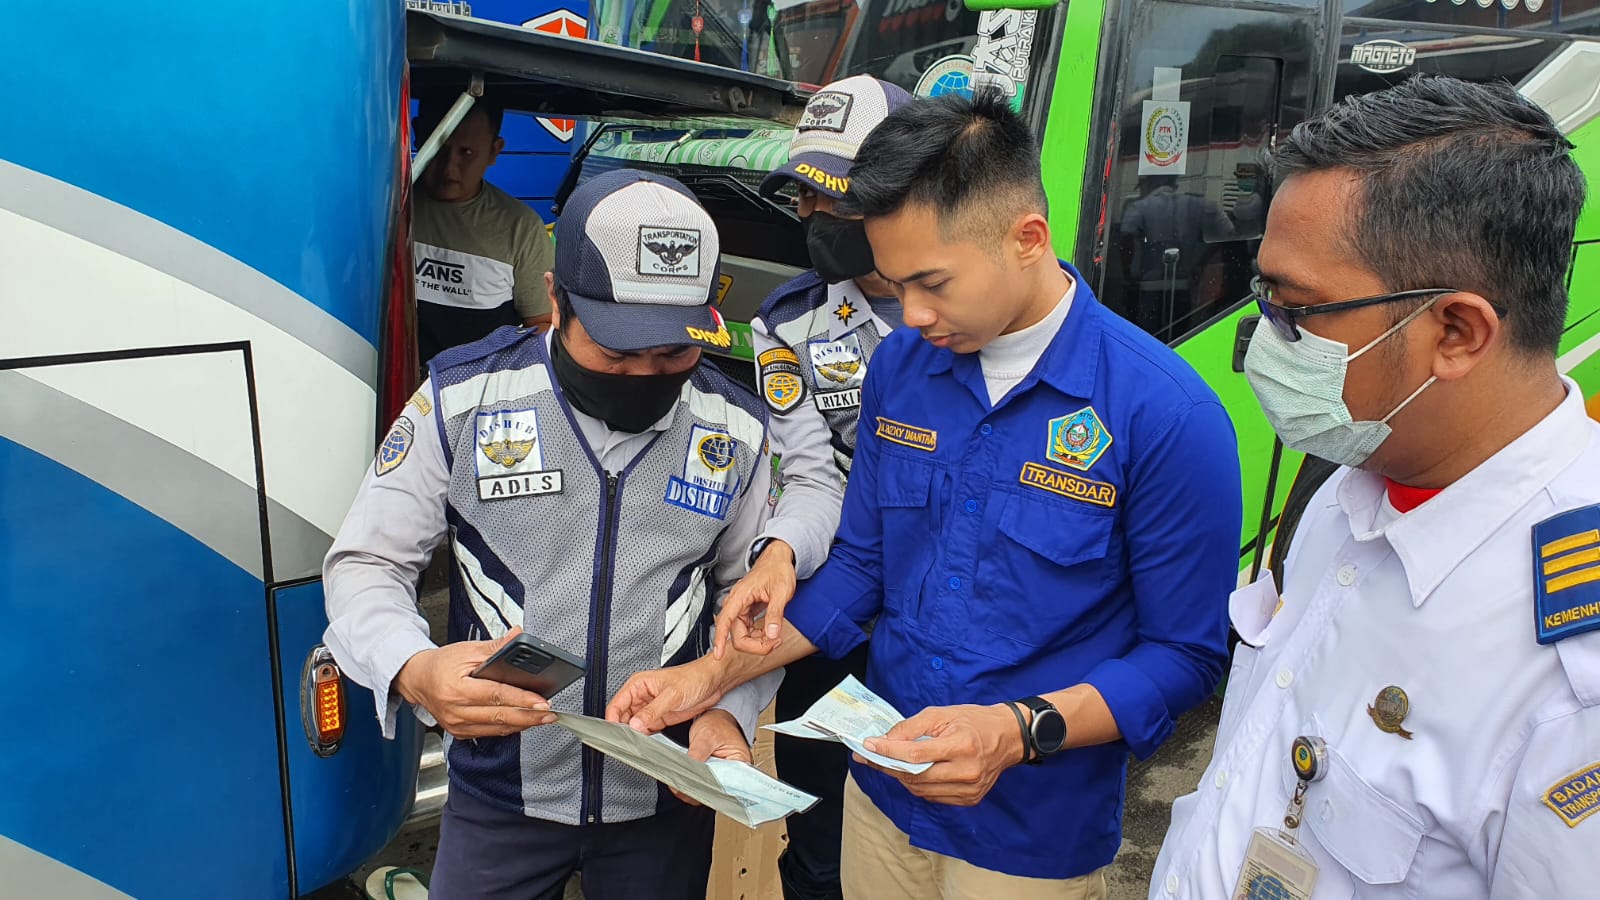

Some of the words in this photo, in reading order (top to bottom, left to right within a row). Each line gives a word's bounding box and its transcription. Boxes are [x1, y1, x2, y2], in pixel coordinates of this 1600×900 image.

[1014, 26, 1035, 80] PUTRA
[1350, 45, 1416, 65] MAGNETO
[805, 118, 833, 126] CORPS
[795, 163, 849, 194] DISHU
[643, 231, 698, 244] TRANSPORTATION
[414, 256, 465, 284] VANS
[652, 263, 689, 273] CORPS
[422, 281, 440, 291] THE
[814, 345, 859, 361] DISHUB
[822, 392, 856, 408] RIZKI
[479, 420, 534, 438] DISHUB
[1027, 467, 1111, 501] TRANSDAR
[1544, 601, 1600, 628] KEMENH
